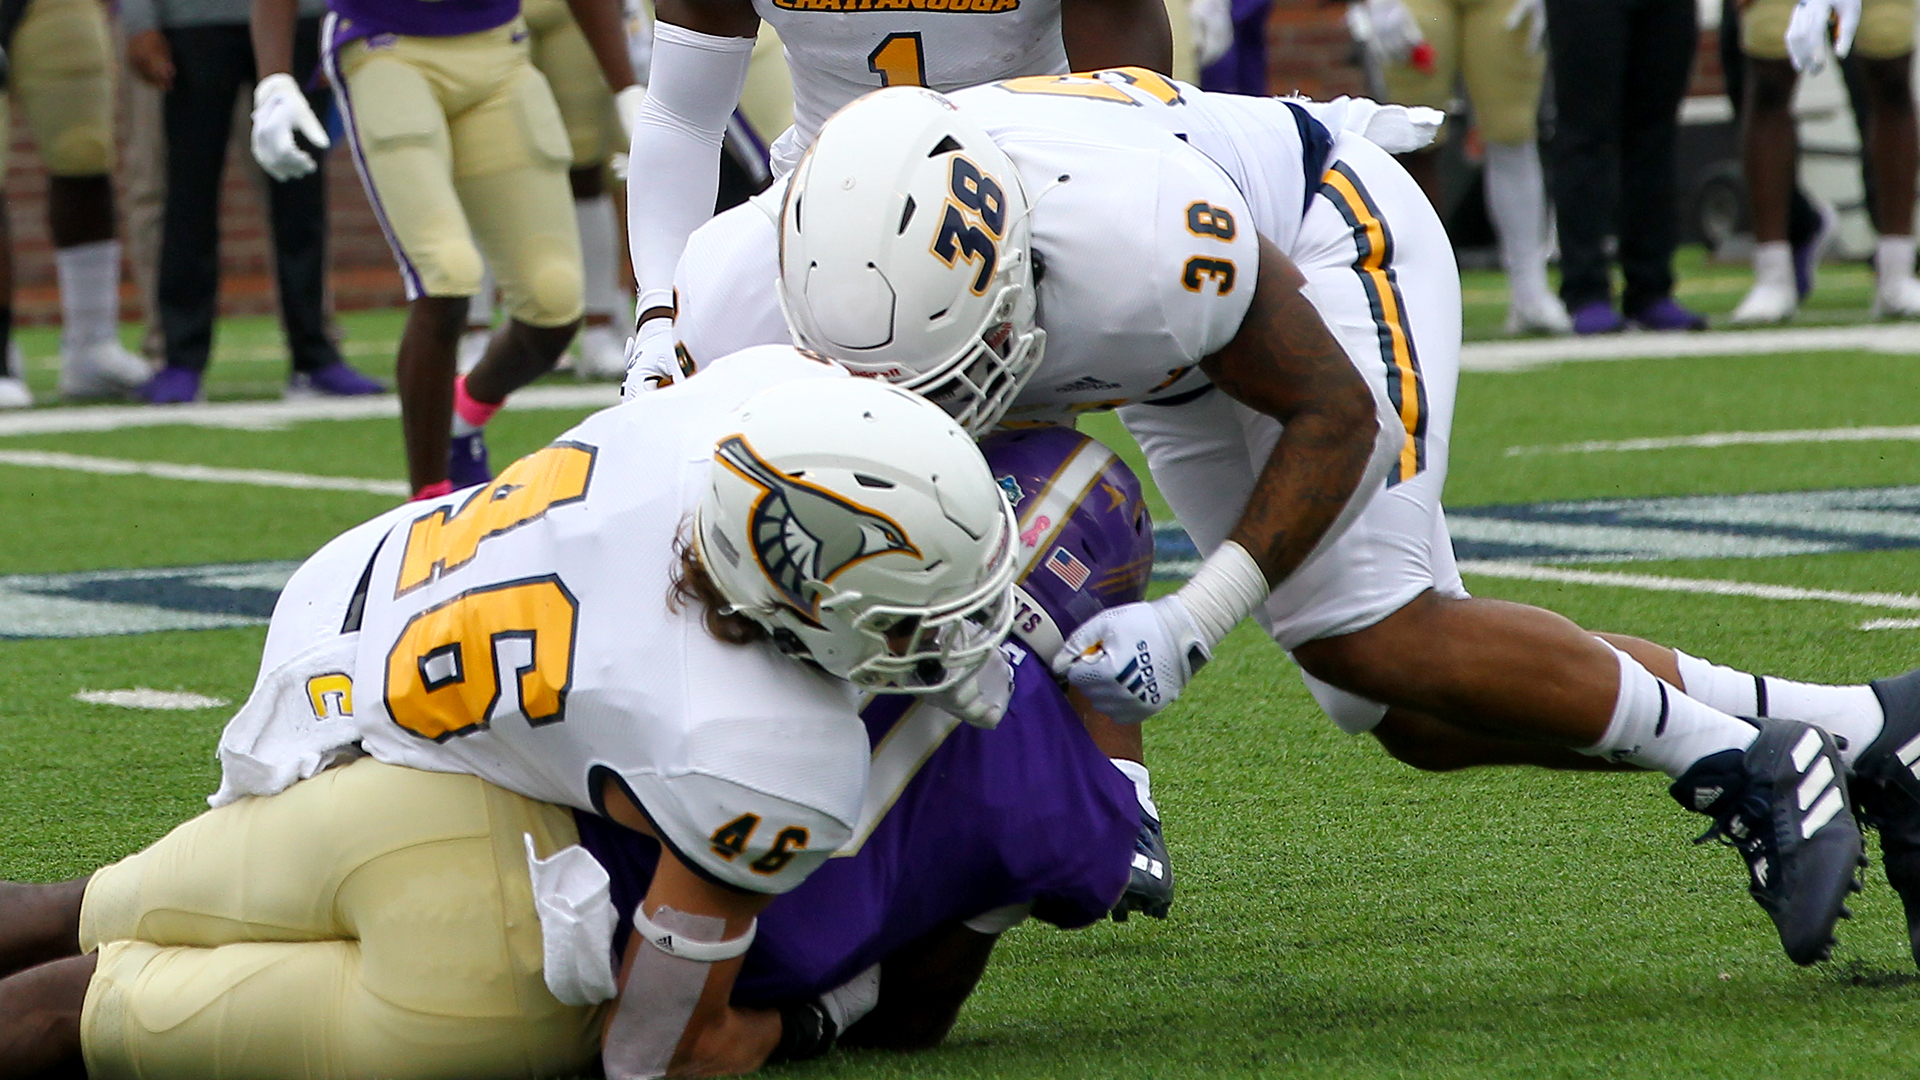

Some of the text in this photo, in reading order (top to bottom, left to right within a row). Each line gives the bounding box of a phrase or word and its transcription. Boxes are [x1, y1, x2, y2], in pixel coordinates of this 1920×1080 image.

[867, 31, 930, 88] 1
[929, 153, 1009, 297] 38
[1181, 200, 1237, 296] 38
[384, 440, 598, 743] 46
[1014, 596, 1042, 633] TS
[1137, 641, 1161, 705] adidas
[710, 812, 811, 876] 46
